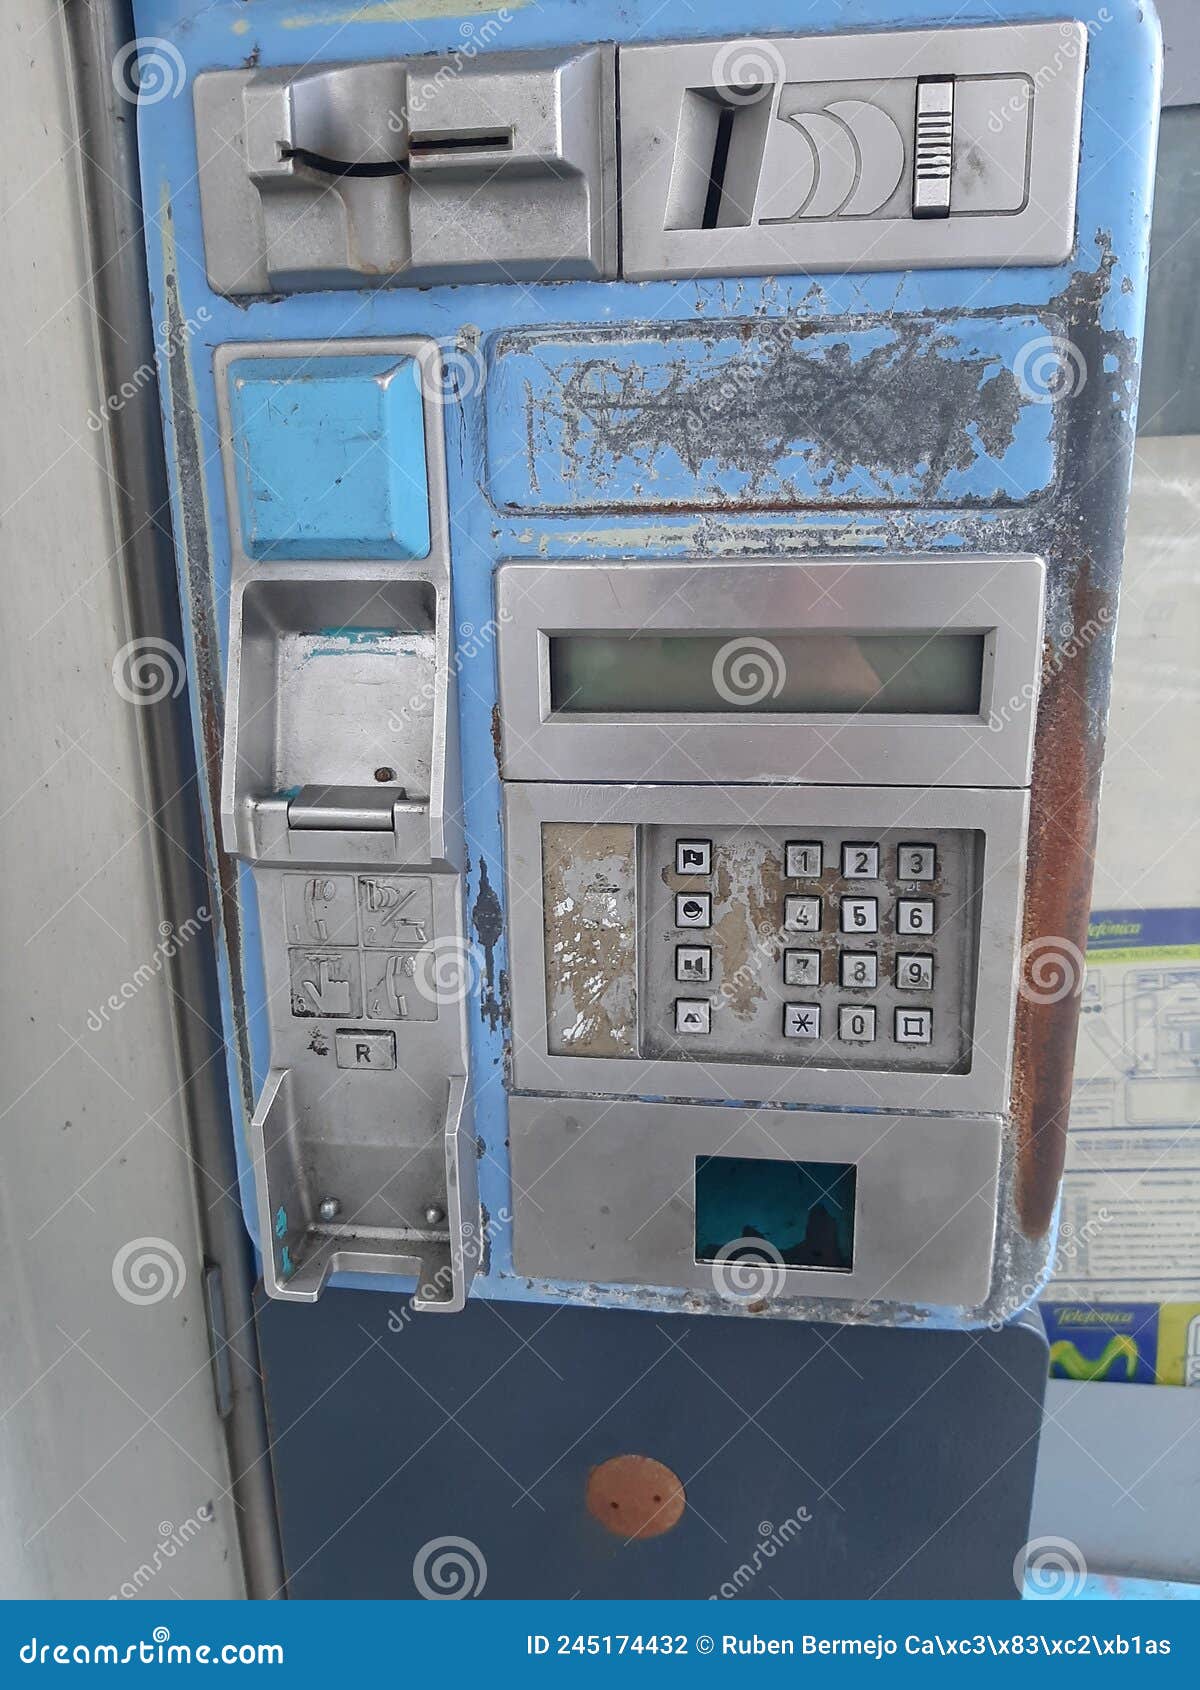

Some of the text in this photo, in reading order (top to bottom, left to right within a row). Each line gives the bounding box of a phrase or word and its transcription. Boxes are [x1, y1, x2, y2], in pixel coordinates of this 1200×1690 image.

[800, 850, 924, 874] 1 2 3
[853, 905, 867, 927] 5
[909, 907, 923, 929] 6
[854, 961, 866, 981] 8
[909, 962, 922, 983] 9
[852, 1014, 864, 1035] 0
[356, 1043, 371, 1063] R
